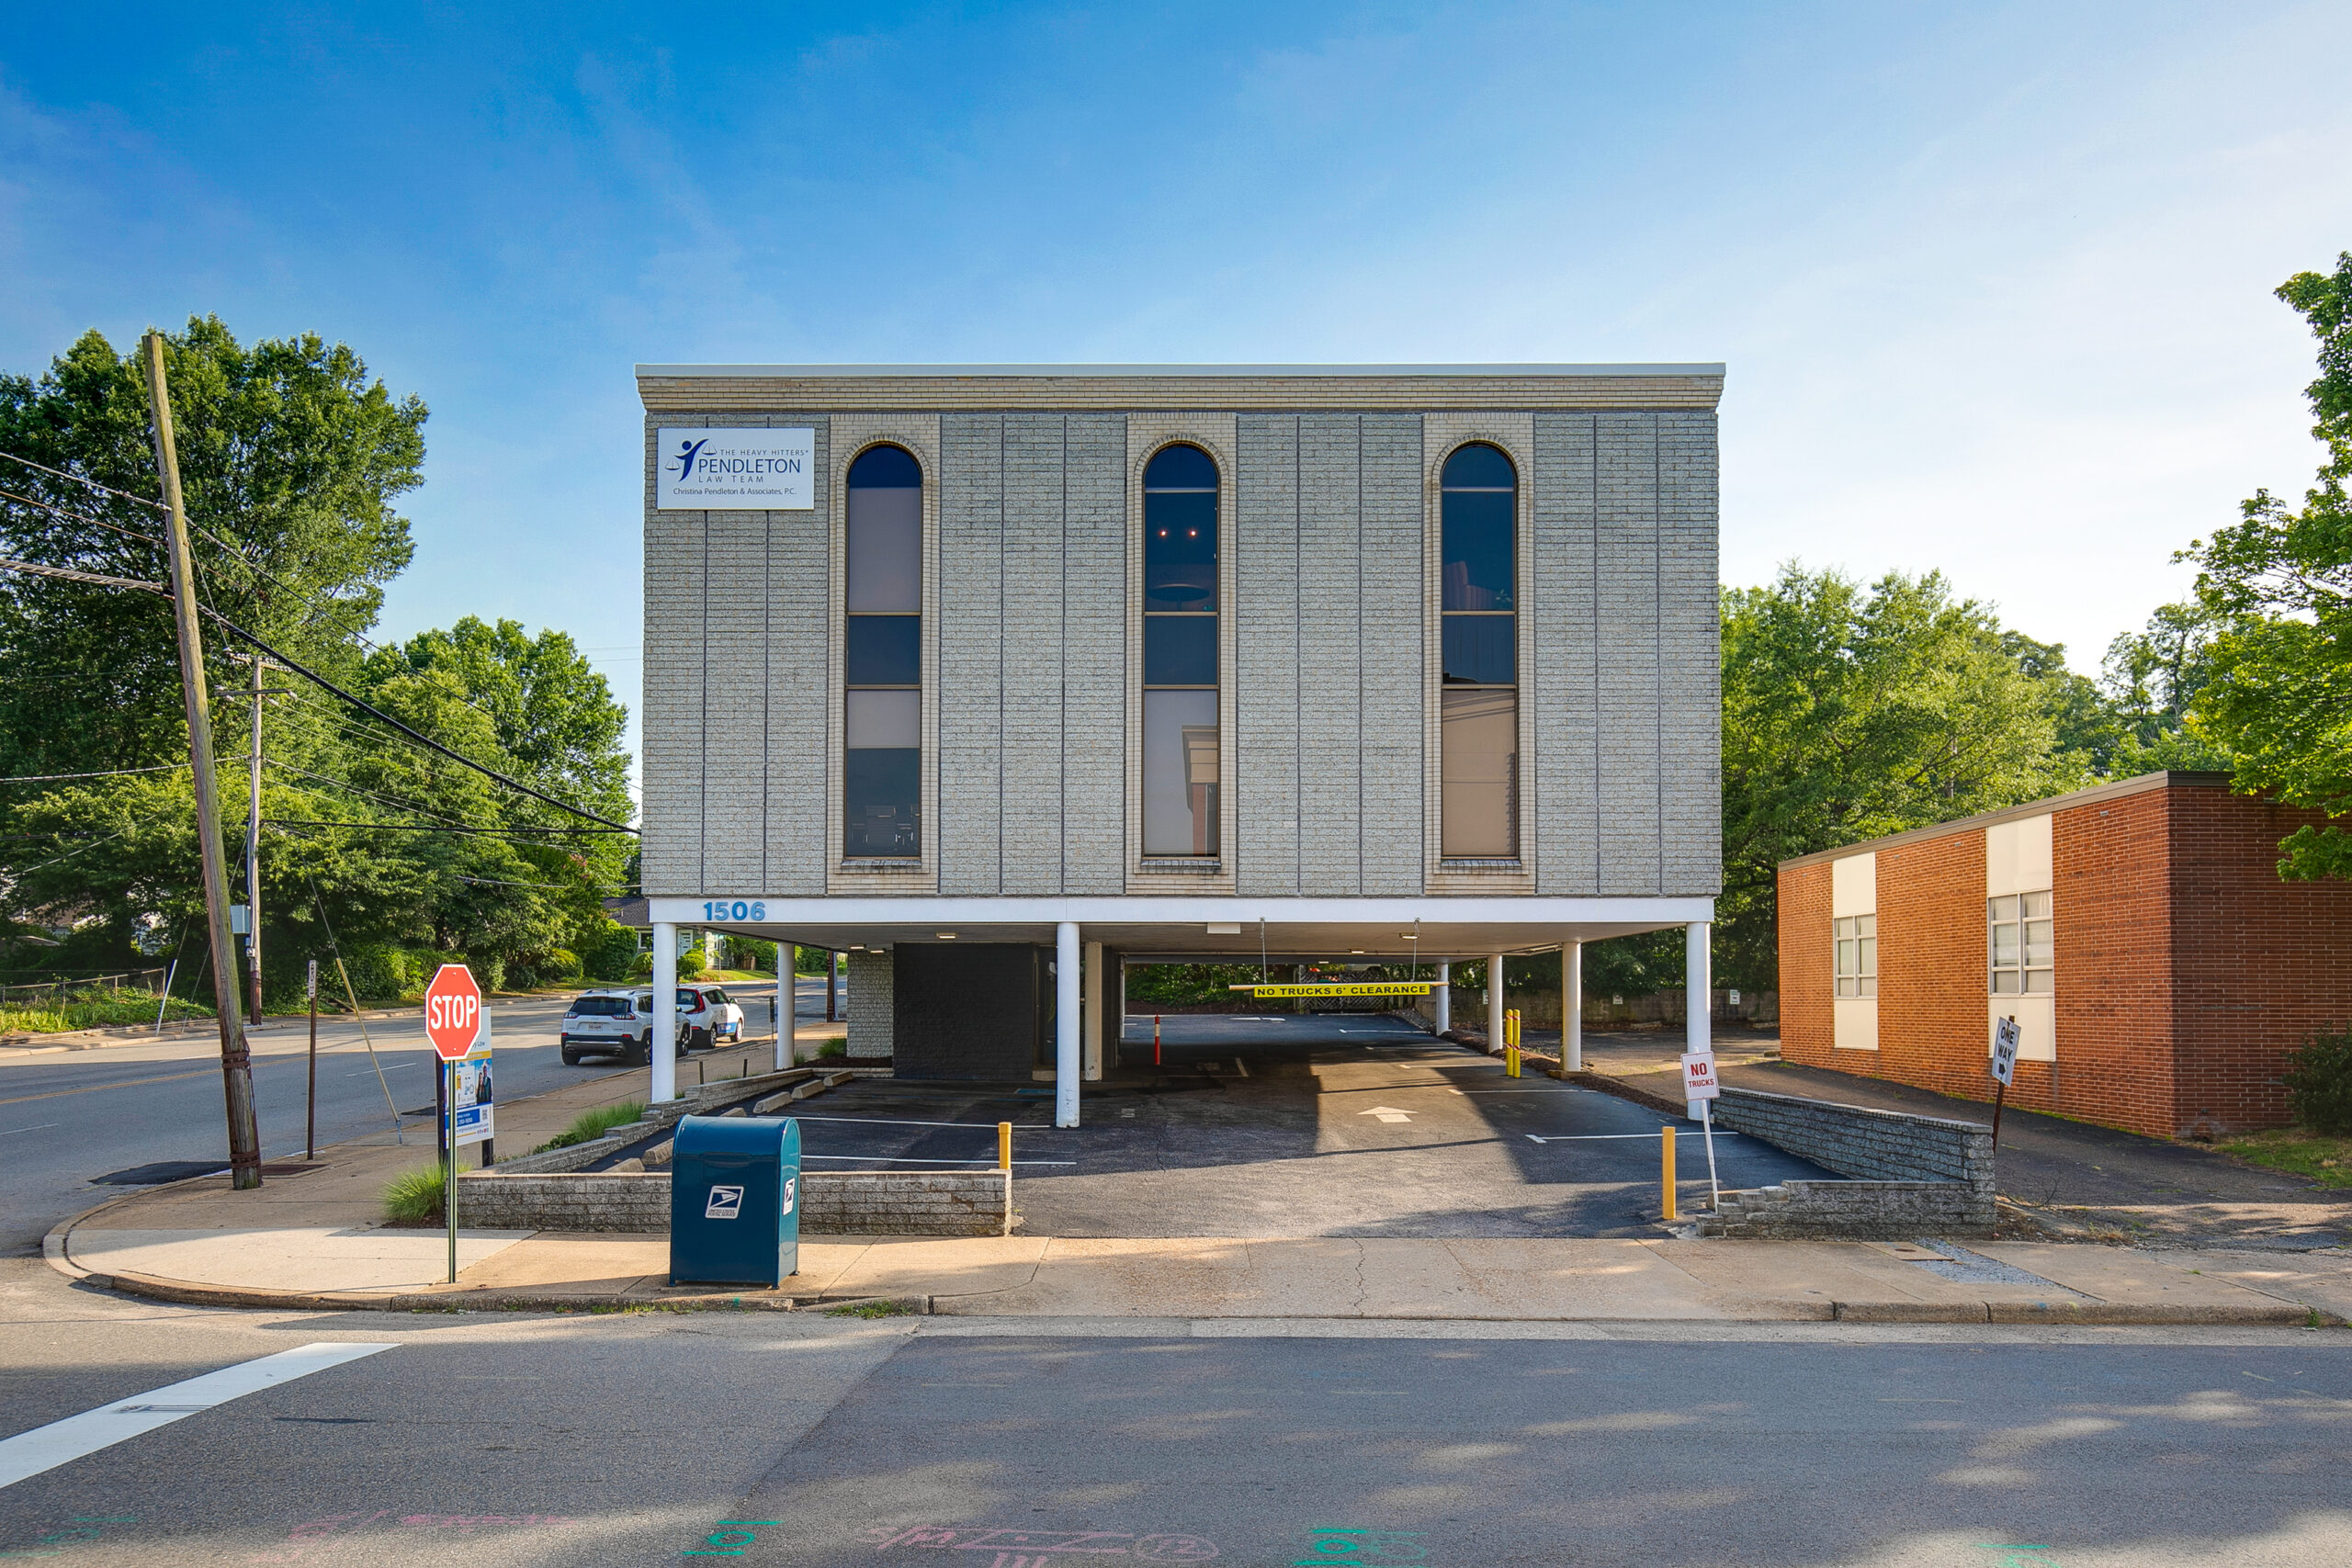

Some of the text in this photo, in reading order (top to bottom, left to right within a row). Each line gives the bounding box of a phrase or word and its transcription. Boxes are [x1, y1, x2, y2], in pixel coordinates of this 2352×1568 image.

[698, 458, 801, 473] PENDLETON
[698, 475, 764, 483] LAW TEAM
[704, 487, 739, 495] Pendleton
[747, 487, 783, 496] Associates,
[784, 487, 797, 495] P.C.
[703, 901, 766, 921] 1506
[1257, 987, 1275, 996] NO
[1279, 987, 1331, 996] TRUCKS
[1351, 985, 1427, 995] CLEARANCE
[430, 995, 478, 1030] STOP
[2000, 1026, 2015, 1044] ONE
[1997, 1043, 2013, 1063] WAY
[1690, 1062, 1707, 1077] NO
[1688, 1078, 1714, 1088] TRUCKS
